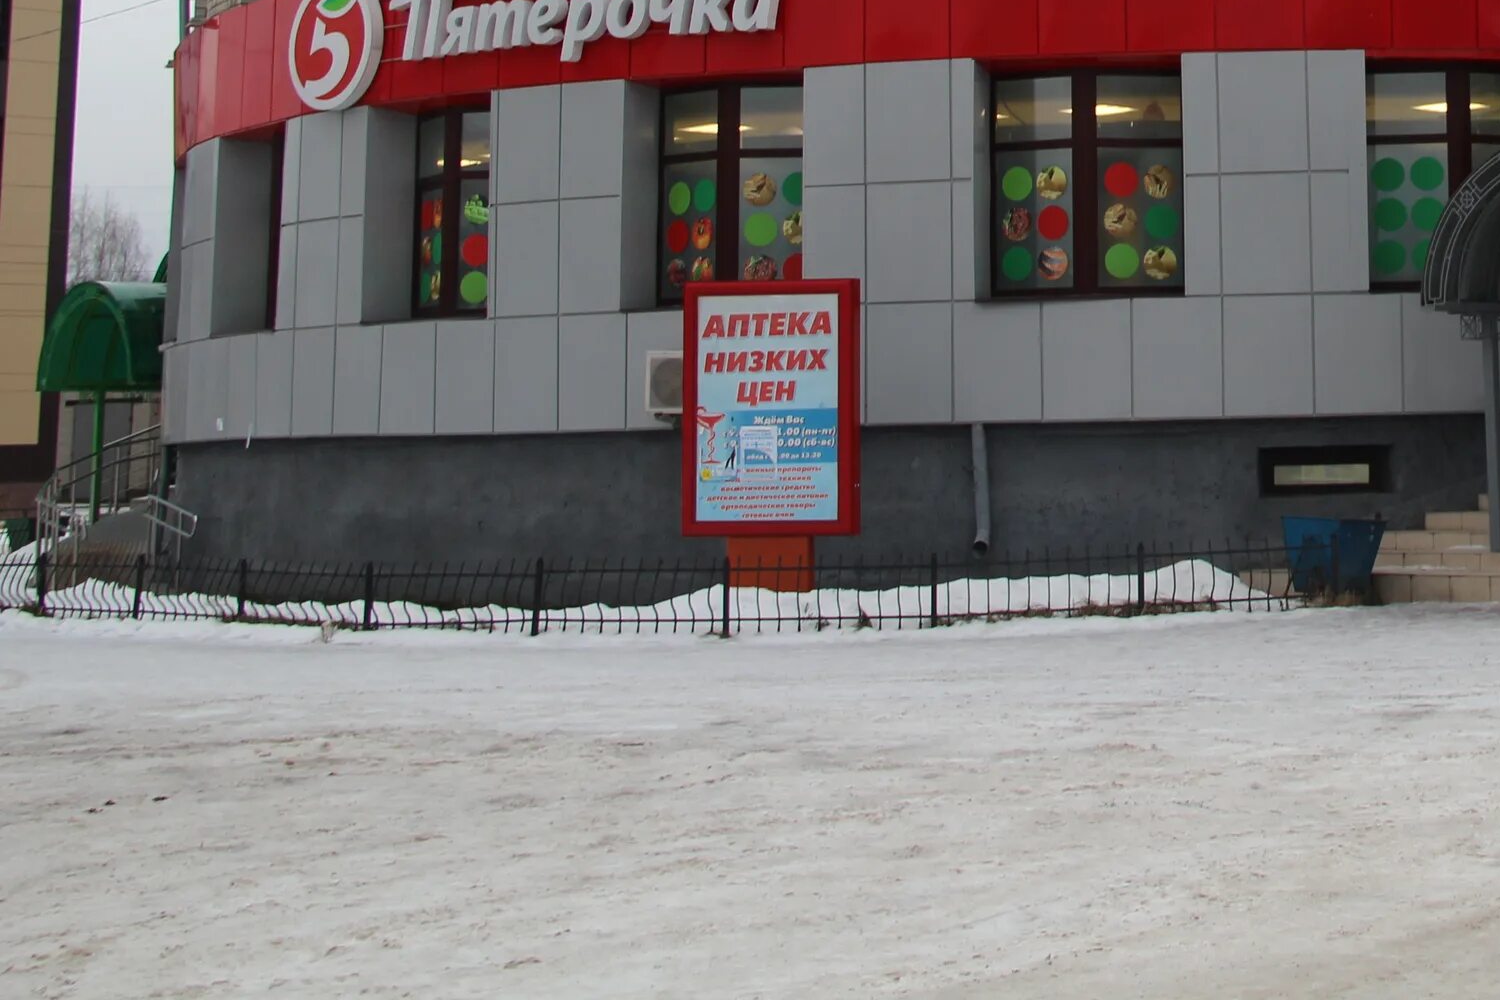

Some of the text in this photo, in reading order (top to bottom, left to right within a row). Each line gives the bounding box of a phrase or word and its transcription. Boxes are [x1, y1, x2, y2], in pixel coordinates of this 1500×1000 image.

[702, 311, 832, 339] АПТЕКА
[704, 349, 828, 373] НИЗКИХ
[737, 380, 796, 406] ЦЕН
